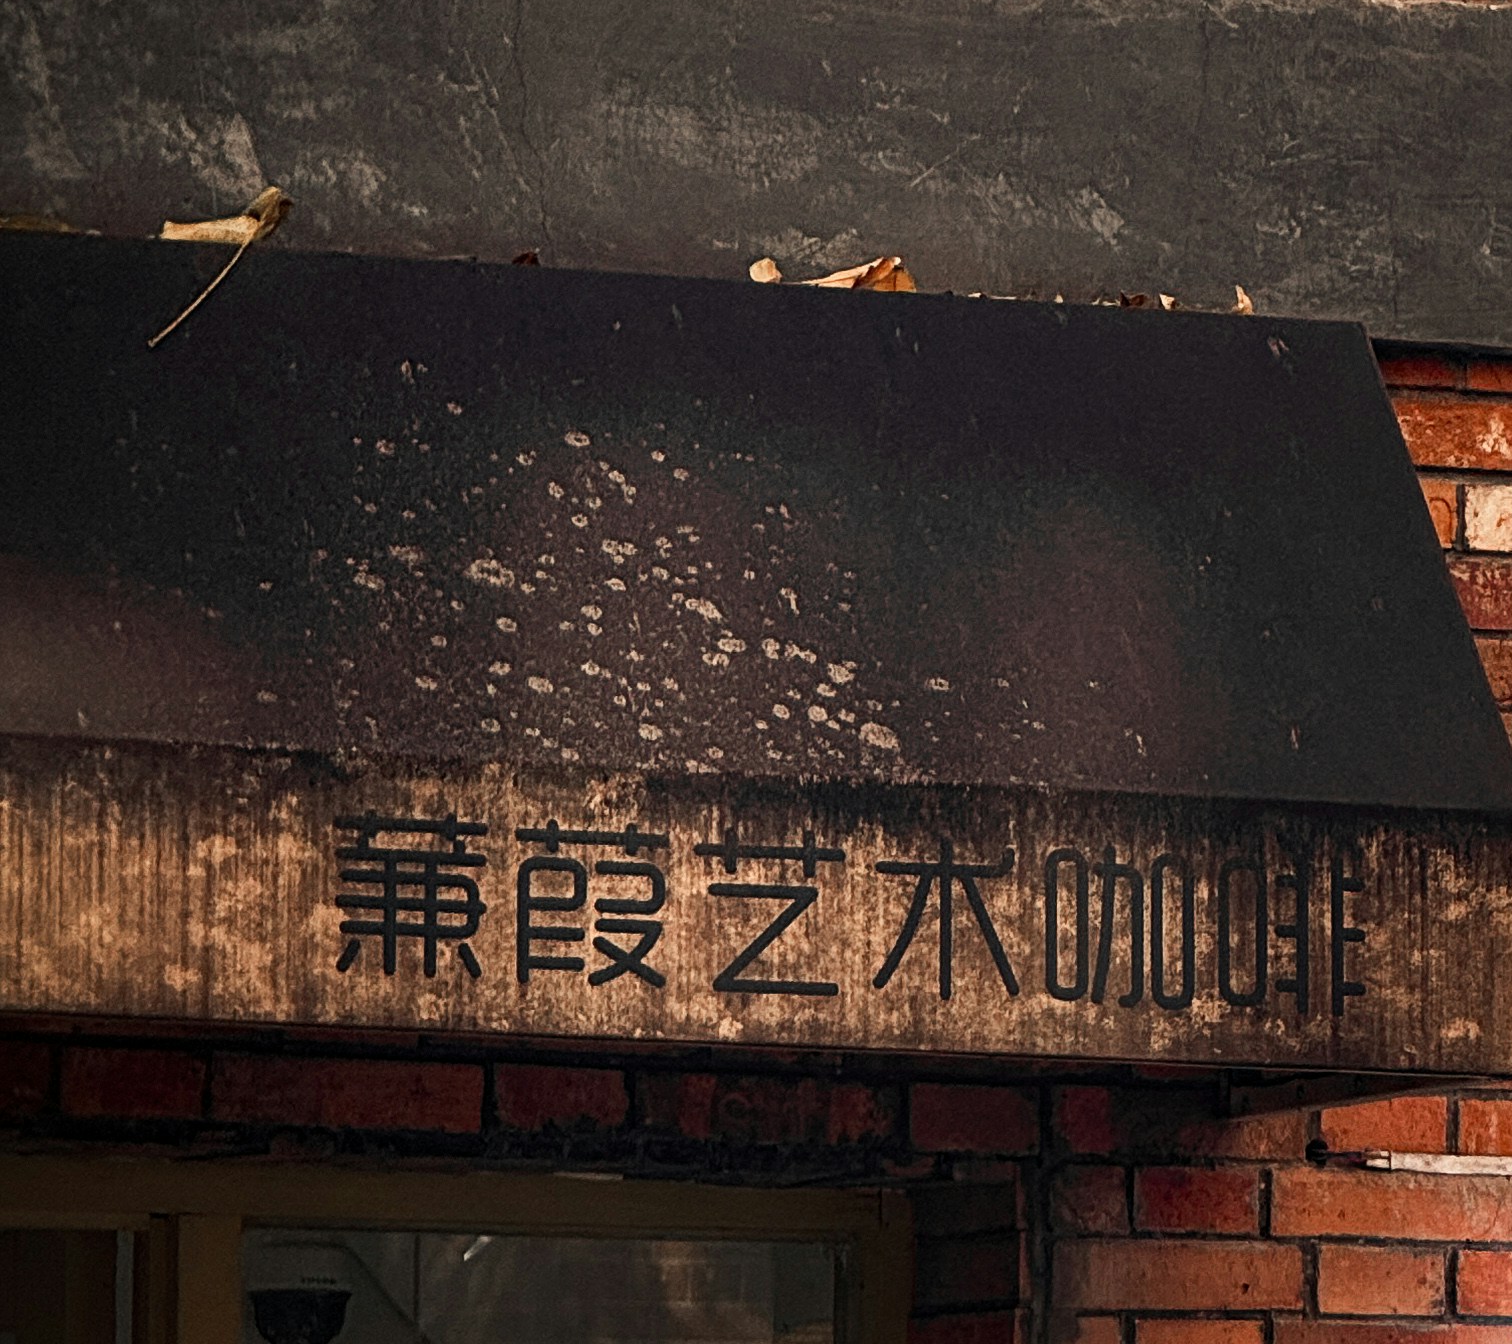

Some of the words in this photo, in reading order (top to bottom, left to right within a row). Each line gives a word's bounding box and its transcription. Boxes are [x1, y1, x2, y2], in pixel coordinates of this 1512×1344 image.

[333, 813, 1367, 1018] 蒹葭艺术咖啡
